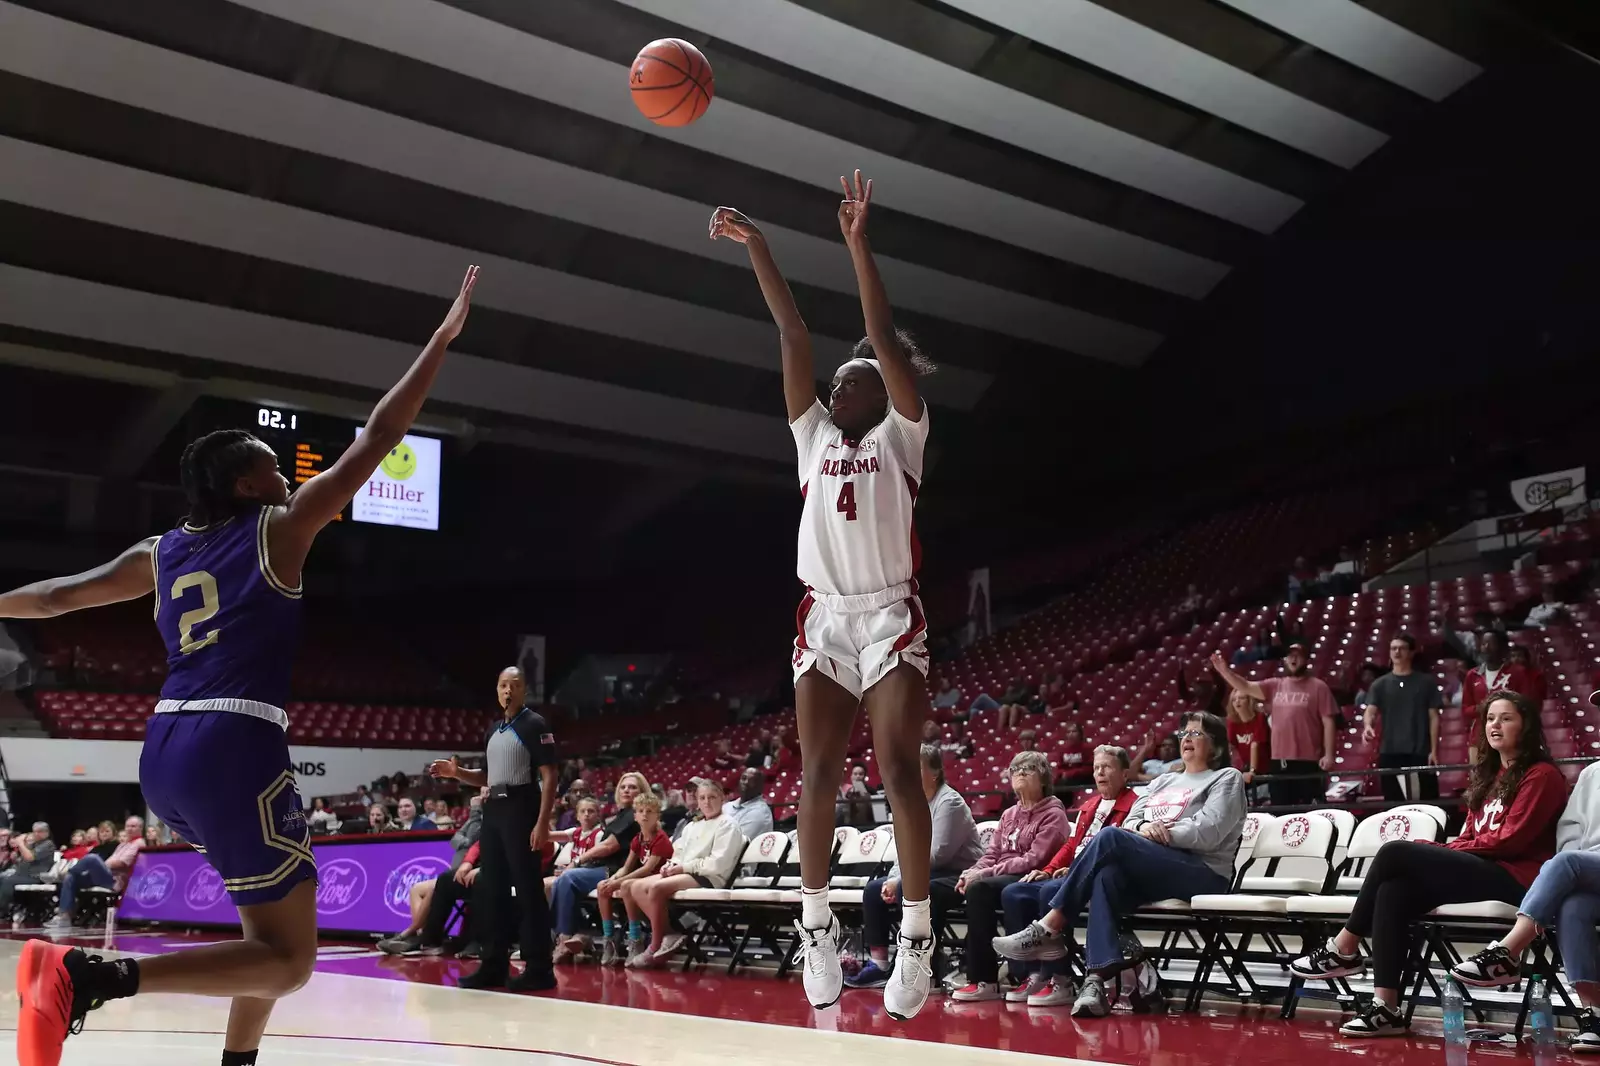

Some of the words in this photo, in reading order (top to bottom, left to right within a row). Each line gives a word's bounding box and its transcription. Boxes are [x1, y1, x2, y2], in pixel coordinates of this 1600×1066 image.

[368, 481, 425, 503] Hiller
[836, 481, 857, 521] 4
[171, 570, 220, 656] 2
[316, 865, 359, 905] Ford
